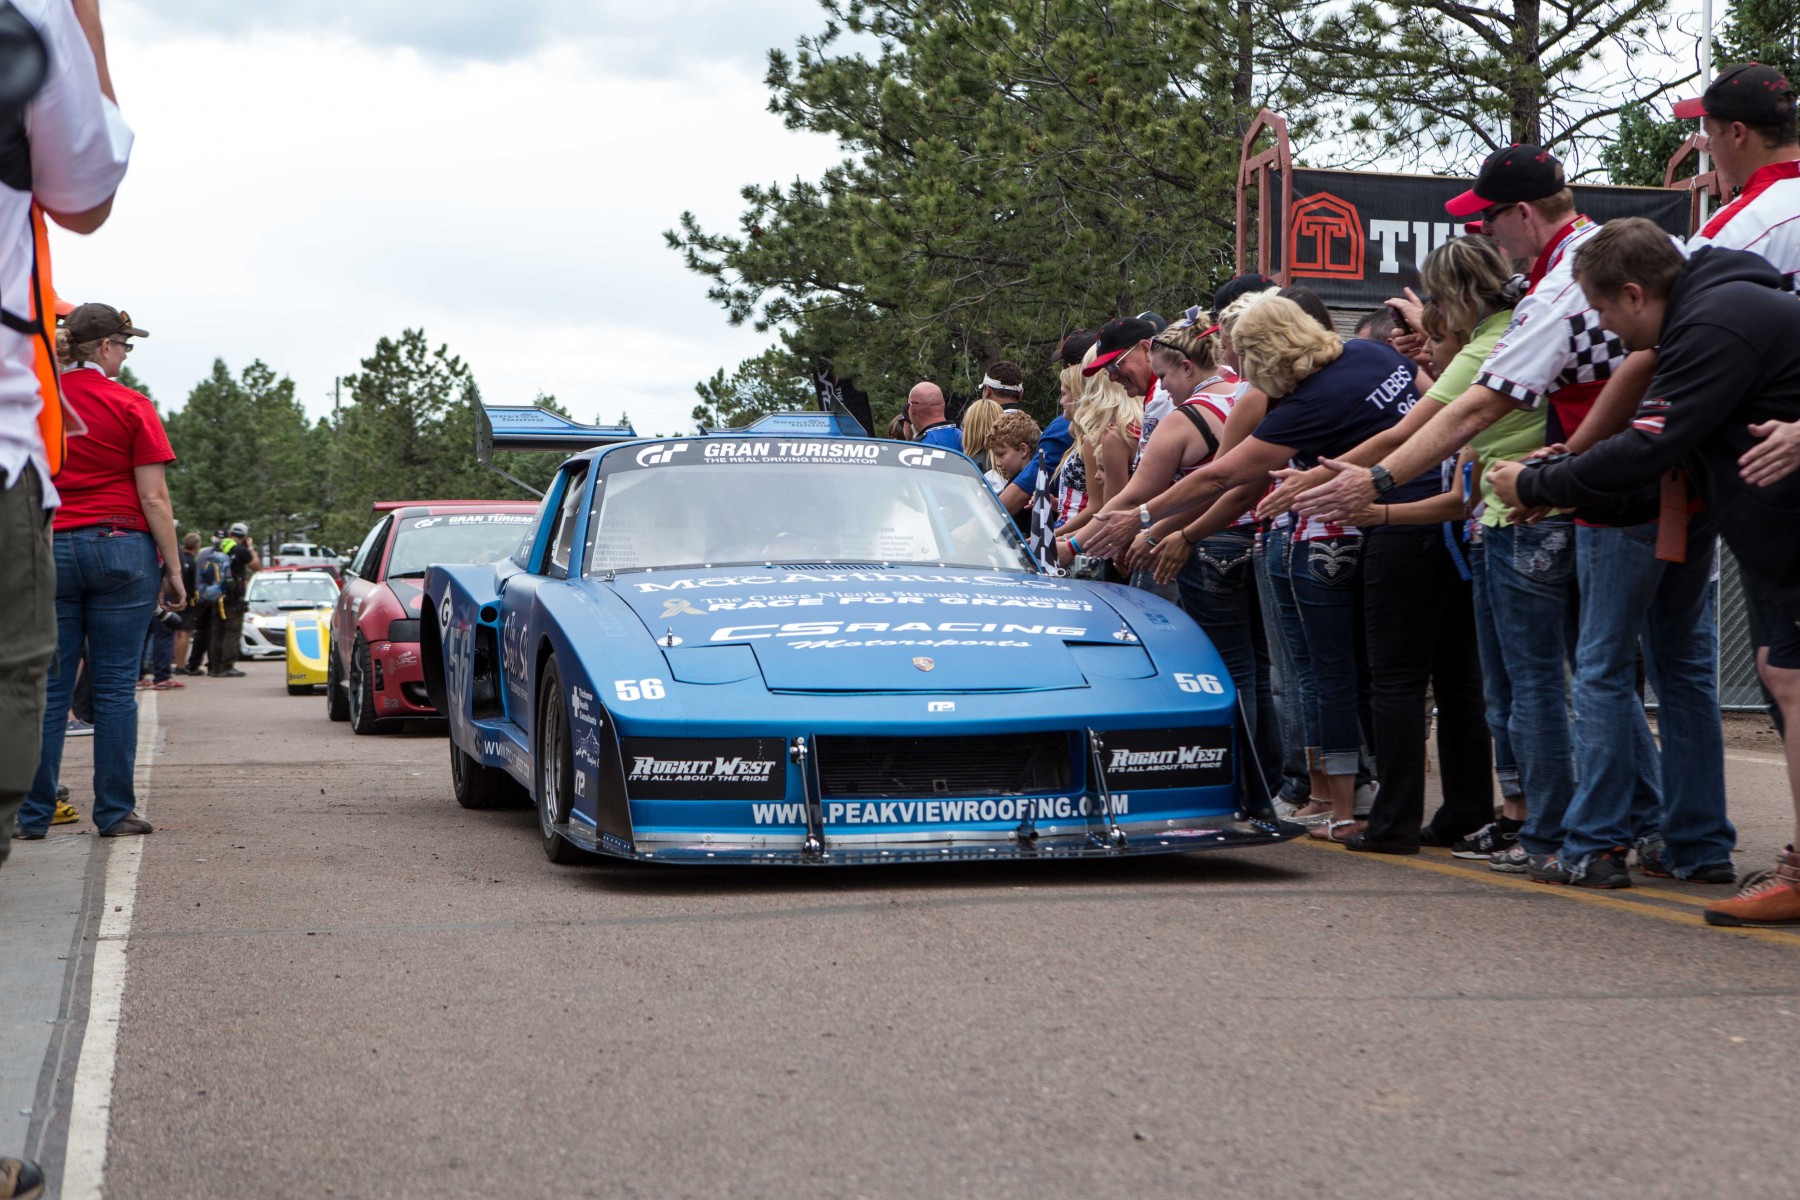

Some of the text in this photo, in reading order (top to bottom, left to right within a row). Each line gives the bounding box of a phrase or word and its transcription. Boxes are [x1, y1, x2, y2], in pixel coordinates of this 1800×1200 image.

[1365, 364, 1413, 410] TUBBS
[704, 442, 770, 457] GRAN
[811, 457, 878, 465] SIMULATOR
[486, 515, 537, 523] TURISM
[702, 590, 1089, 606] The Grace Nicole Strauch Foundation
[708, 596, 1094, 612] RACE FOR GRACE!
[787, 638, 1033, 650] Motorsports
[614, 678, 666, 702] 56
[1173, 672, 1225, 695] 56
[1176, 745, 1228, 764] WEST
[713, 756, 776, 775] WEST
[1107, 766, 1126, 774] IT'S
[1145, 763, 1180, 772] ABOUT
[717, 774, 739, 782] THE
[741, 774, 770, 782] RIDE
